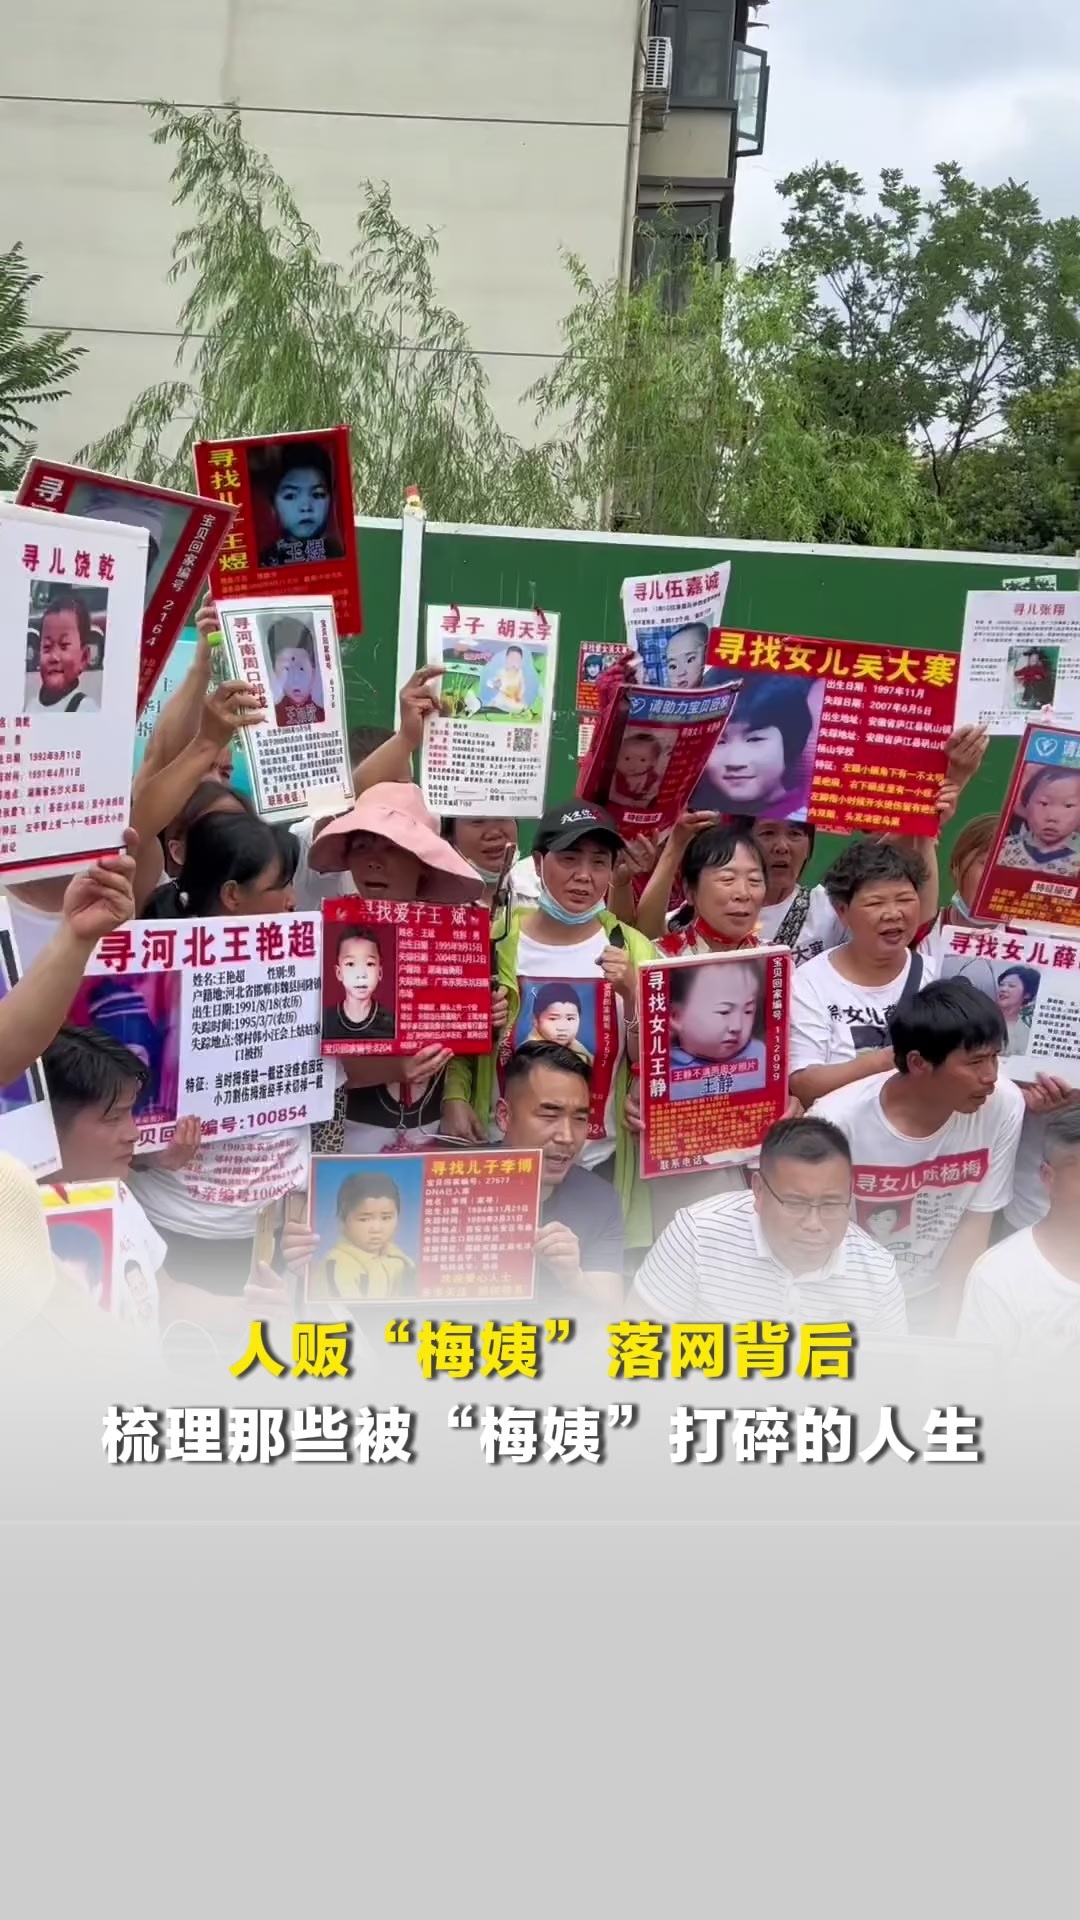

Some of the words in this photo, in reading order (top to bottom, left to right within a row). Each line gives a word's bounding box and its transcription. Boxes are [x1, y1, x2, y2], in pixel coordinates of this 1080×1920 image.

[31, 475, 65, 513] 寻
[208, 449, 250, 572] 寻找儿王煜
[22, 544, 116, 581] 寻儿饶乾
[171, 513, 216, 592] 宝贝回家编号
[633, 571, 720, 601] 寻儿伍嘉诚
[145, 600, 175, 647] 2164
[440, 615, 484, 635] 寻子
[715, 631, 957, 687] 寻找女儿吴大寒
[97, 921, 317, 972] 寻河北王艳超
[950, 932, 1080, 970] 寻找女儿薛
[193, 970, 245, 987] 姓名:王艳超
[267, 965, 295, 980] 性别:男
[771, 957, 783, 1020] 宝贝回家编号
[647, 971, 667, 1098] 寻找女儿王静
[772, 1026, 781, 1081] 112099
[701, 1074, 734, 1094] 王静
[659, 1155, 703, 1170] 联系电话
